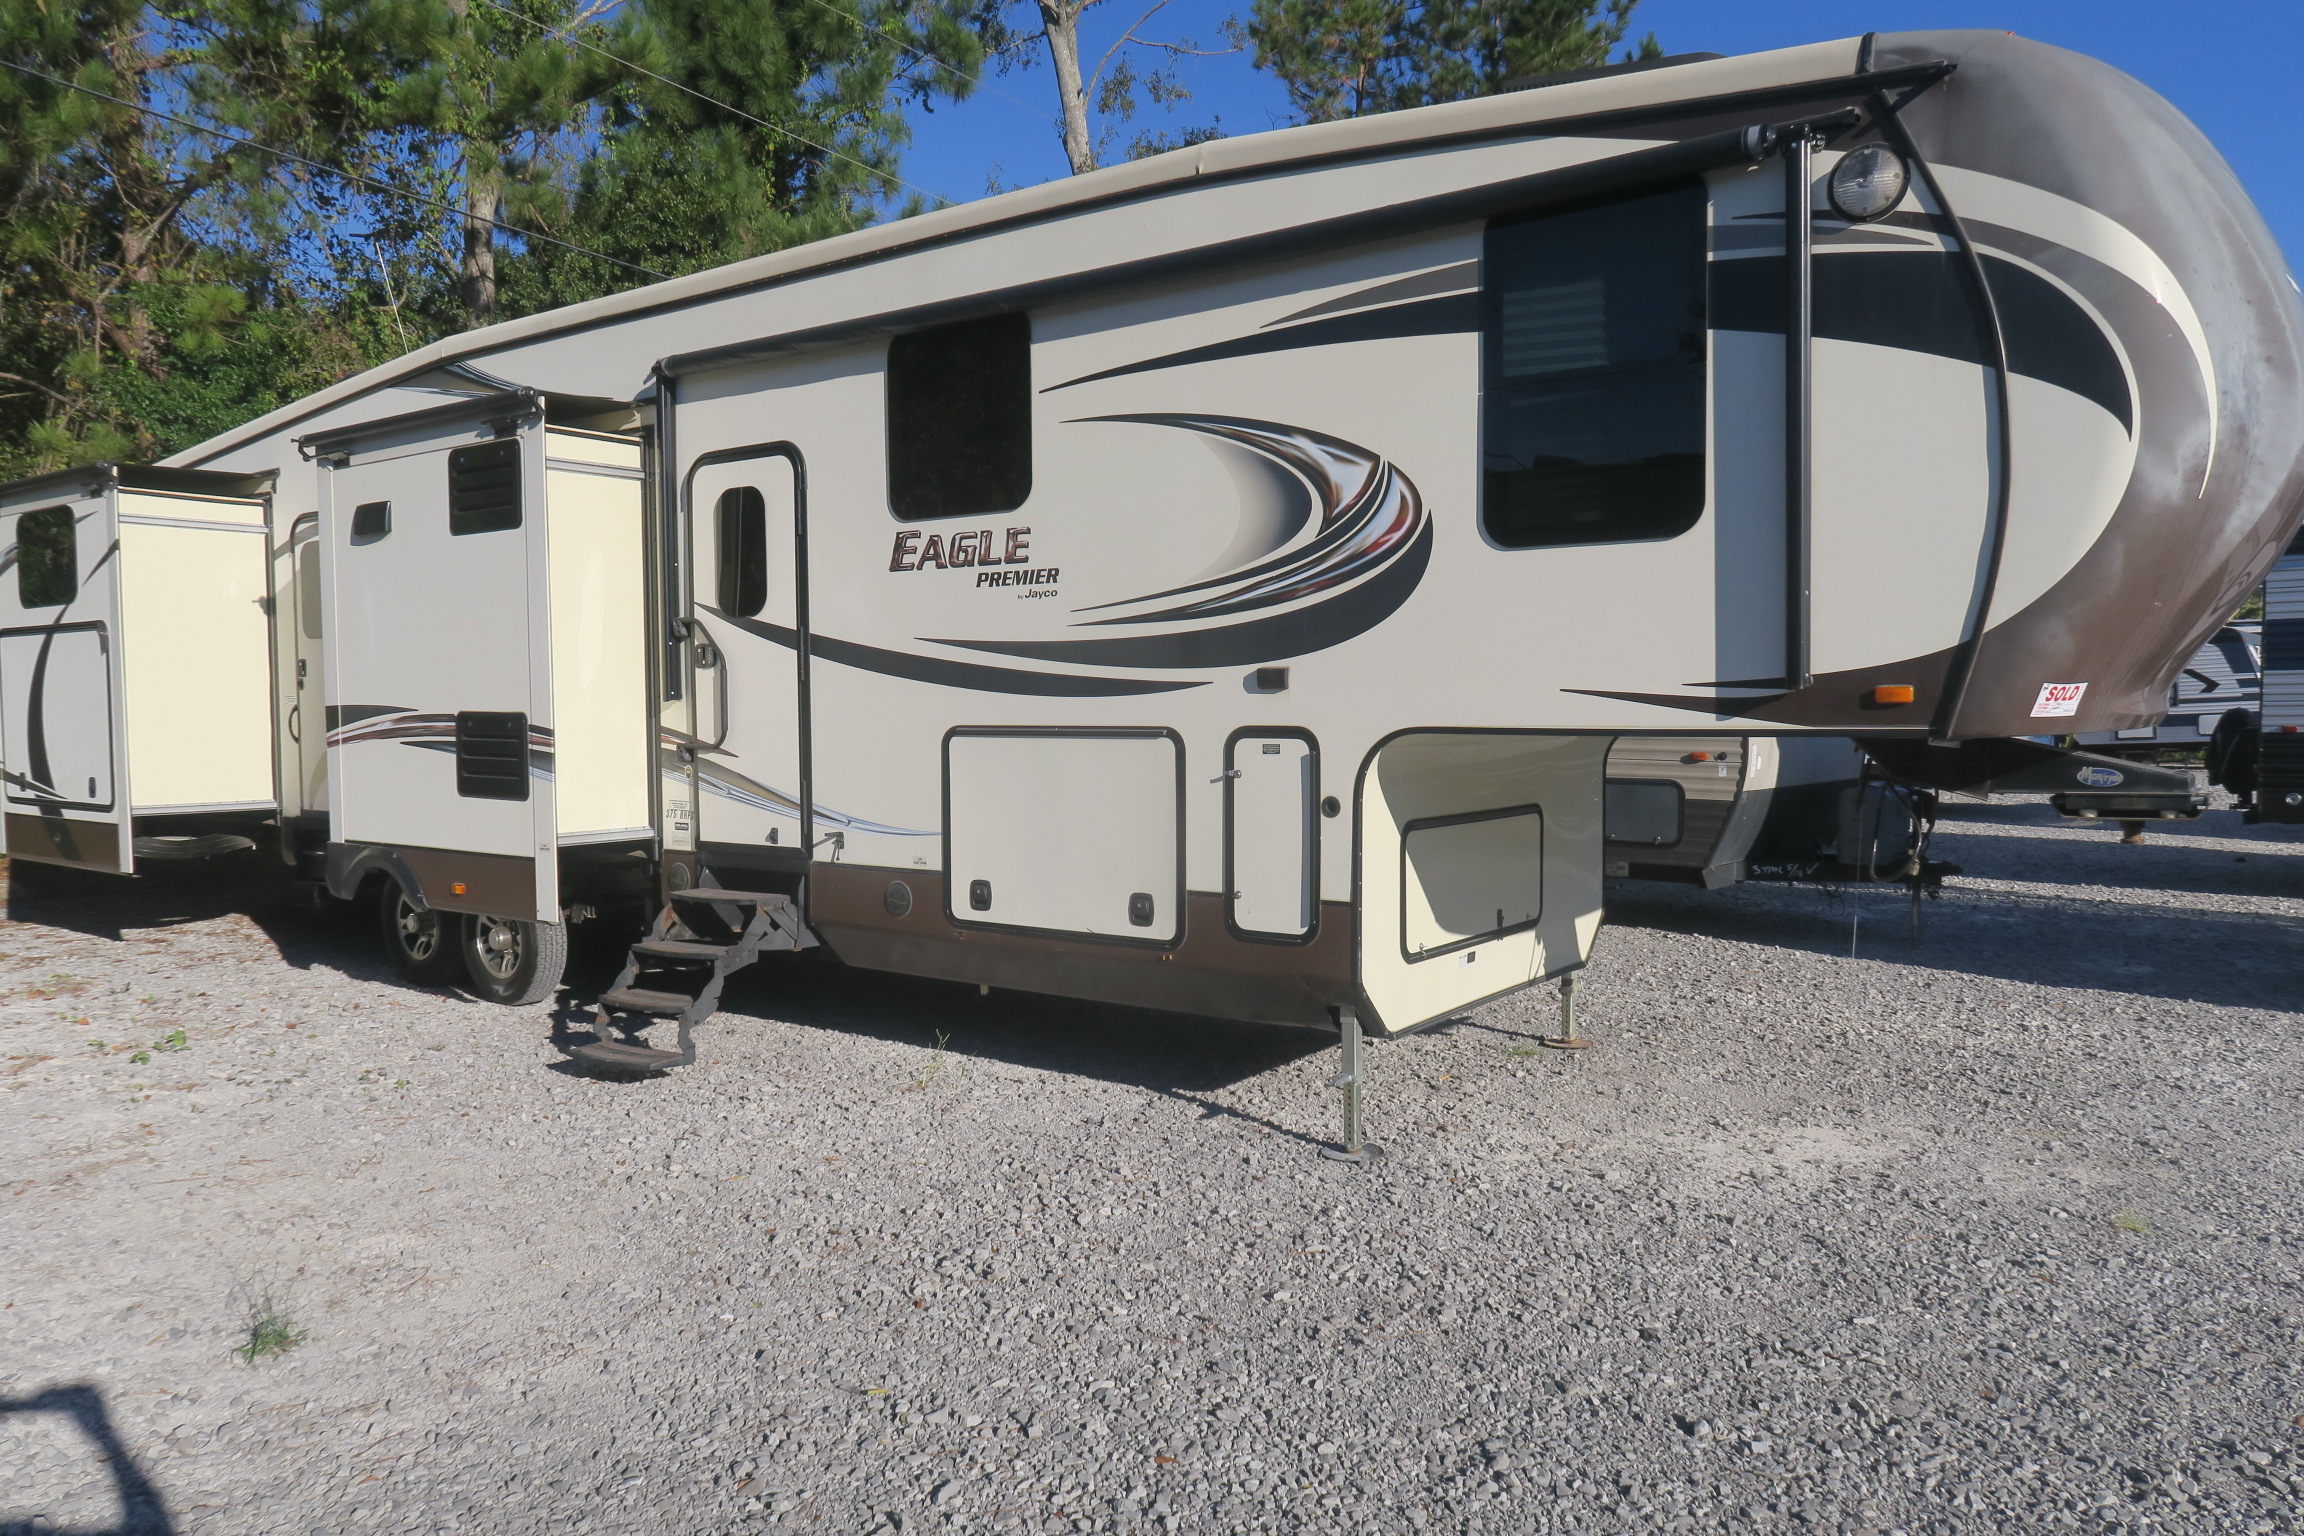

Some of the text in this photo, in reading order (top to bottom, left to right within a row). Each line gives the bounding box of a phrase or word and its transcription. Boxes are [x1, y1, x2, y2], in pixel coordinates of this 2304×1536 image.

[889, 526, 1031, 572] EAGLE
[976, 568, 1060, 587] PREMIER
[1025, 589, 1058, 600] Jayco
[2045, 686, 2080, 702] SOLD
[666, 809, 677, 818] 375
